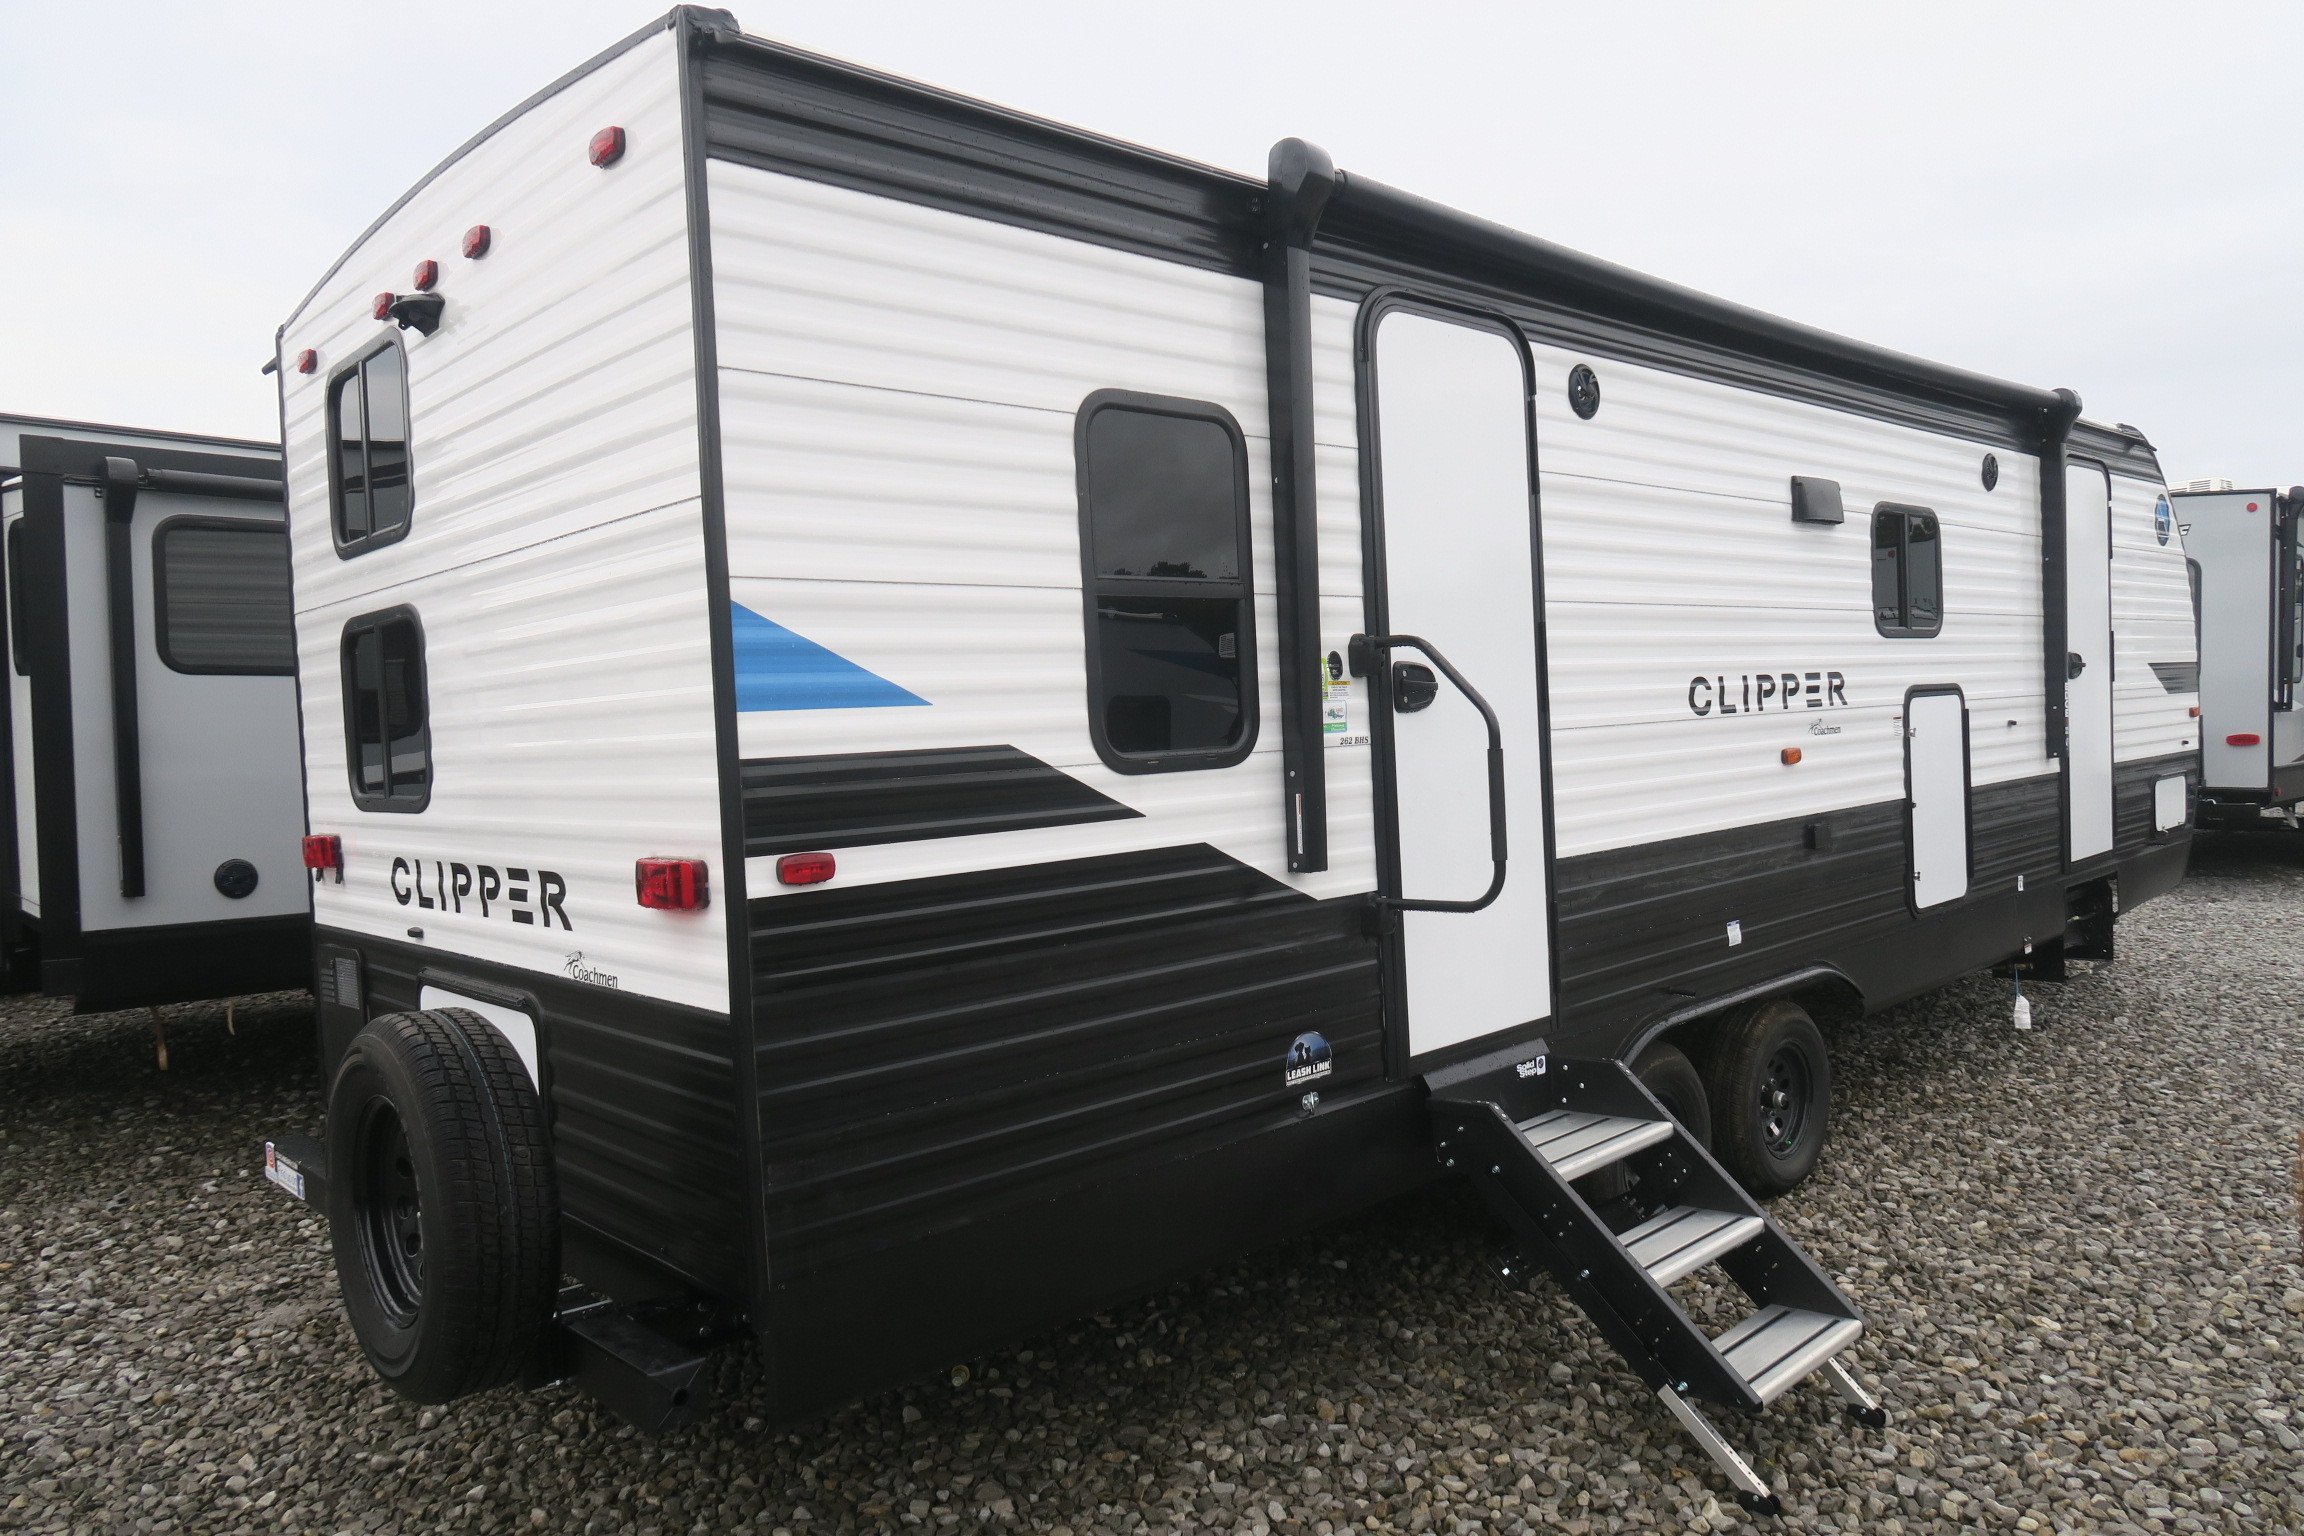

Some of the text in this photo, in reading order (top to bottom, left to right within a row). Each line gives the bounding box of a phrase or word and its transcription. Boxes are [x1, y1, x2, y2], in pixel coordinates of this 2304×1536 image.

[1688, 672, 1848, 716] CLIPPER
[1813, 724, 1842, 736] Coachmen
[1340, 736, 1369, 746] 262 BHS
[391, 857, 573, 931] CLIPPER
[573, 964, 618, 989] Coachmen
[1287, 1065, 1312, 1081] LEASH
[1312, 1060, 1330, 1074] LINK
[1516, 1060, 1535, 1073] Solid
[1519, 1067, 1537, 1079] Step
